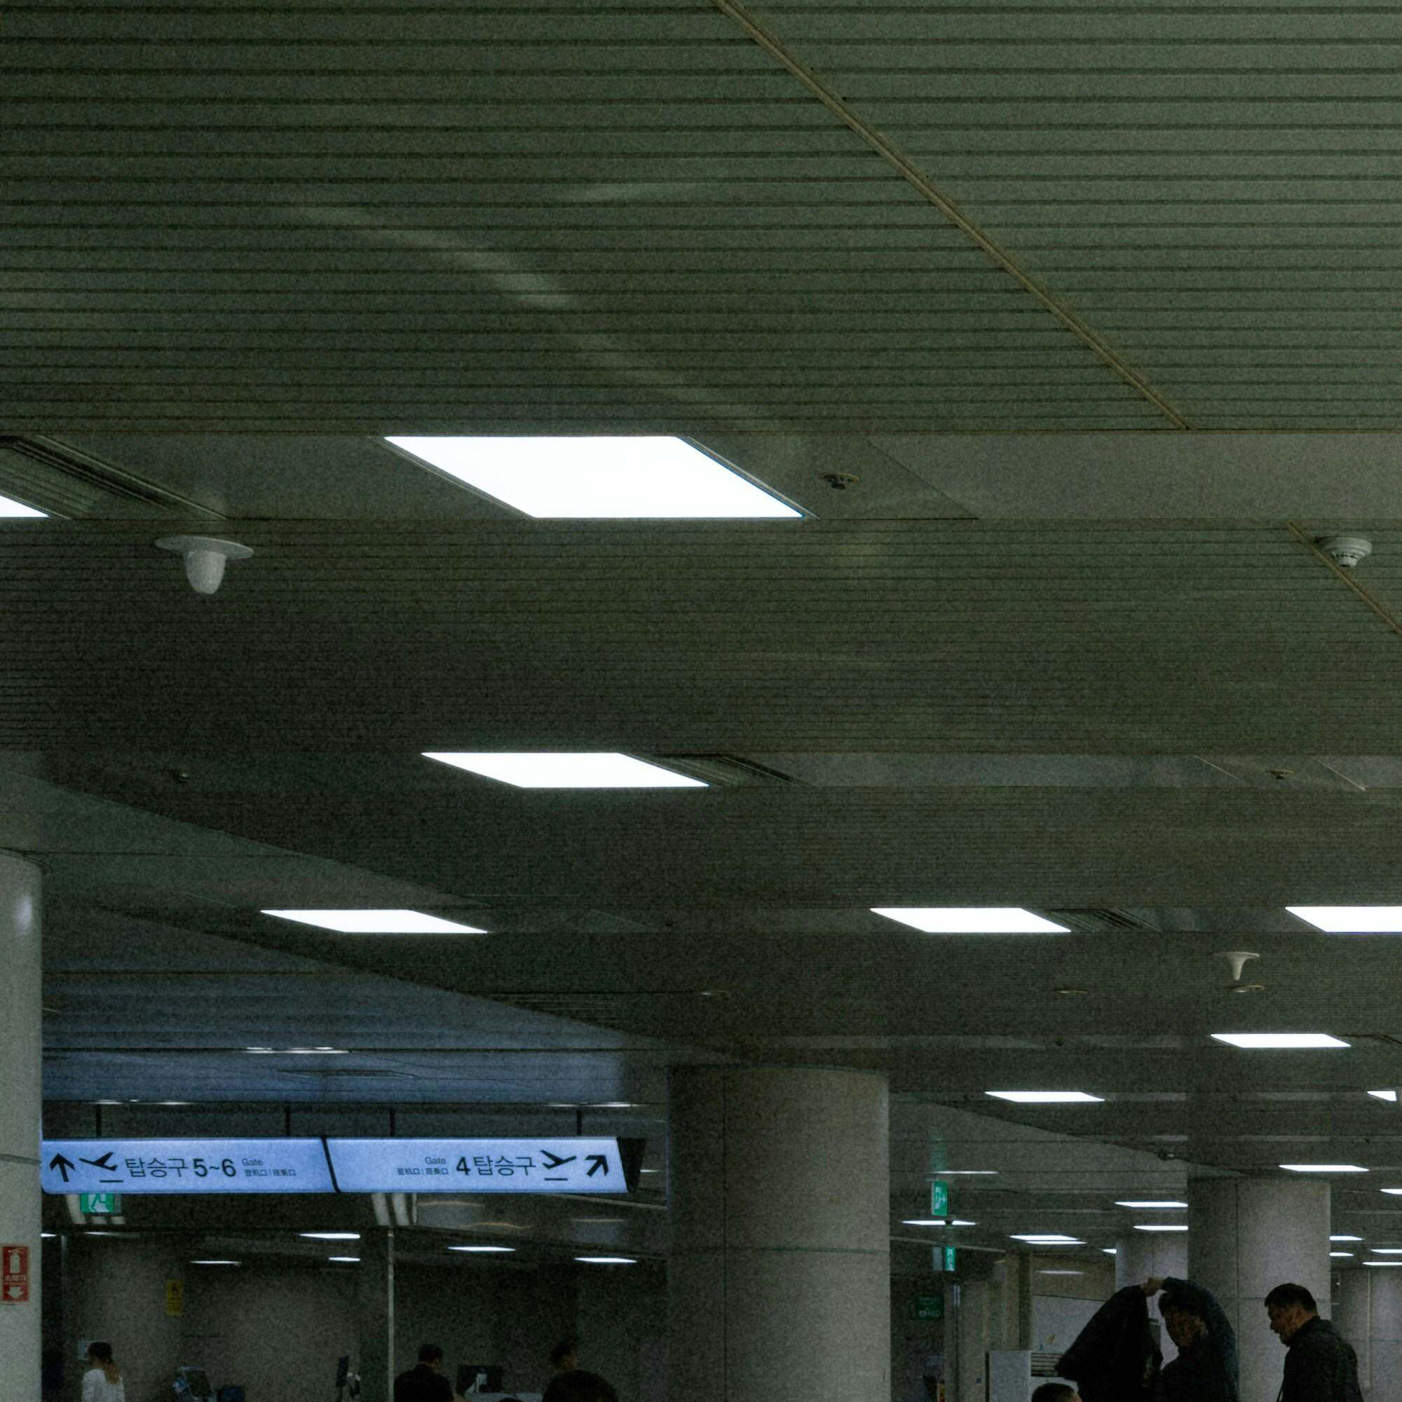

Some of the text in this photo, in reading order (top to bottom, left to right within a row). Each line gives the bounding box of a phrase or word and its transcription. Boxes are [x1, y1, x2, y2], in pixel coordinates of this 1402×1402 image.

[124, 1157, 237, 1179] 탑승구 5~6
[241, 1158, 264, 1167] Gate
[424, 1156, 447, 1165] Gate
[456, 1155, 537, 1177] 4 탑승구
